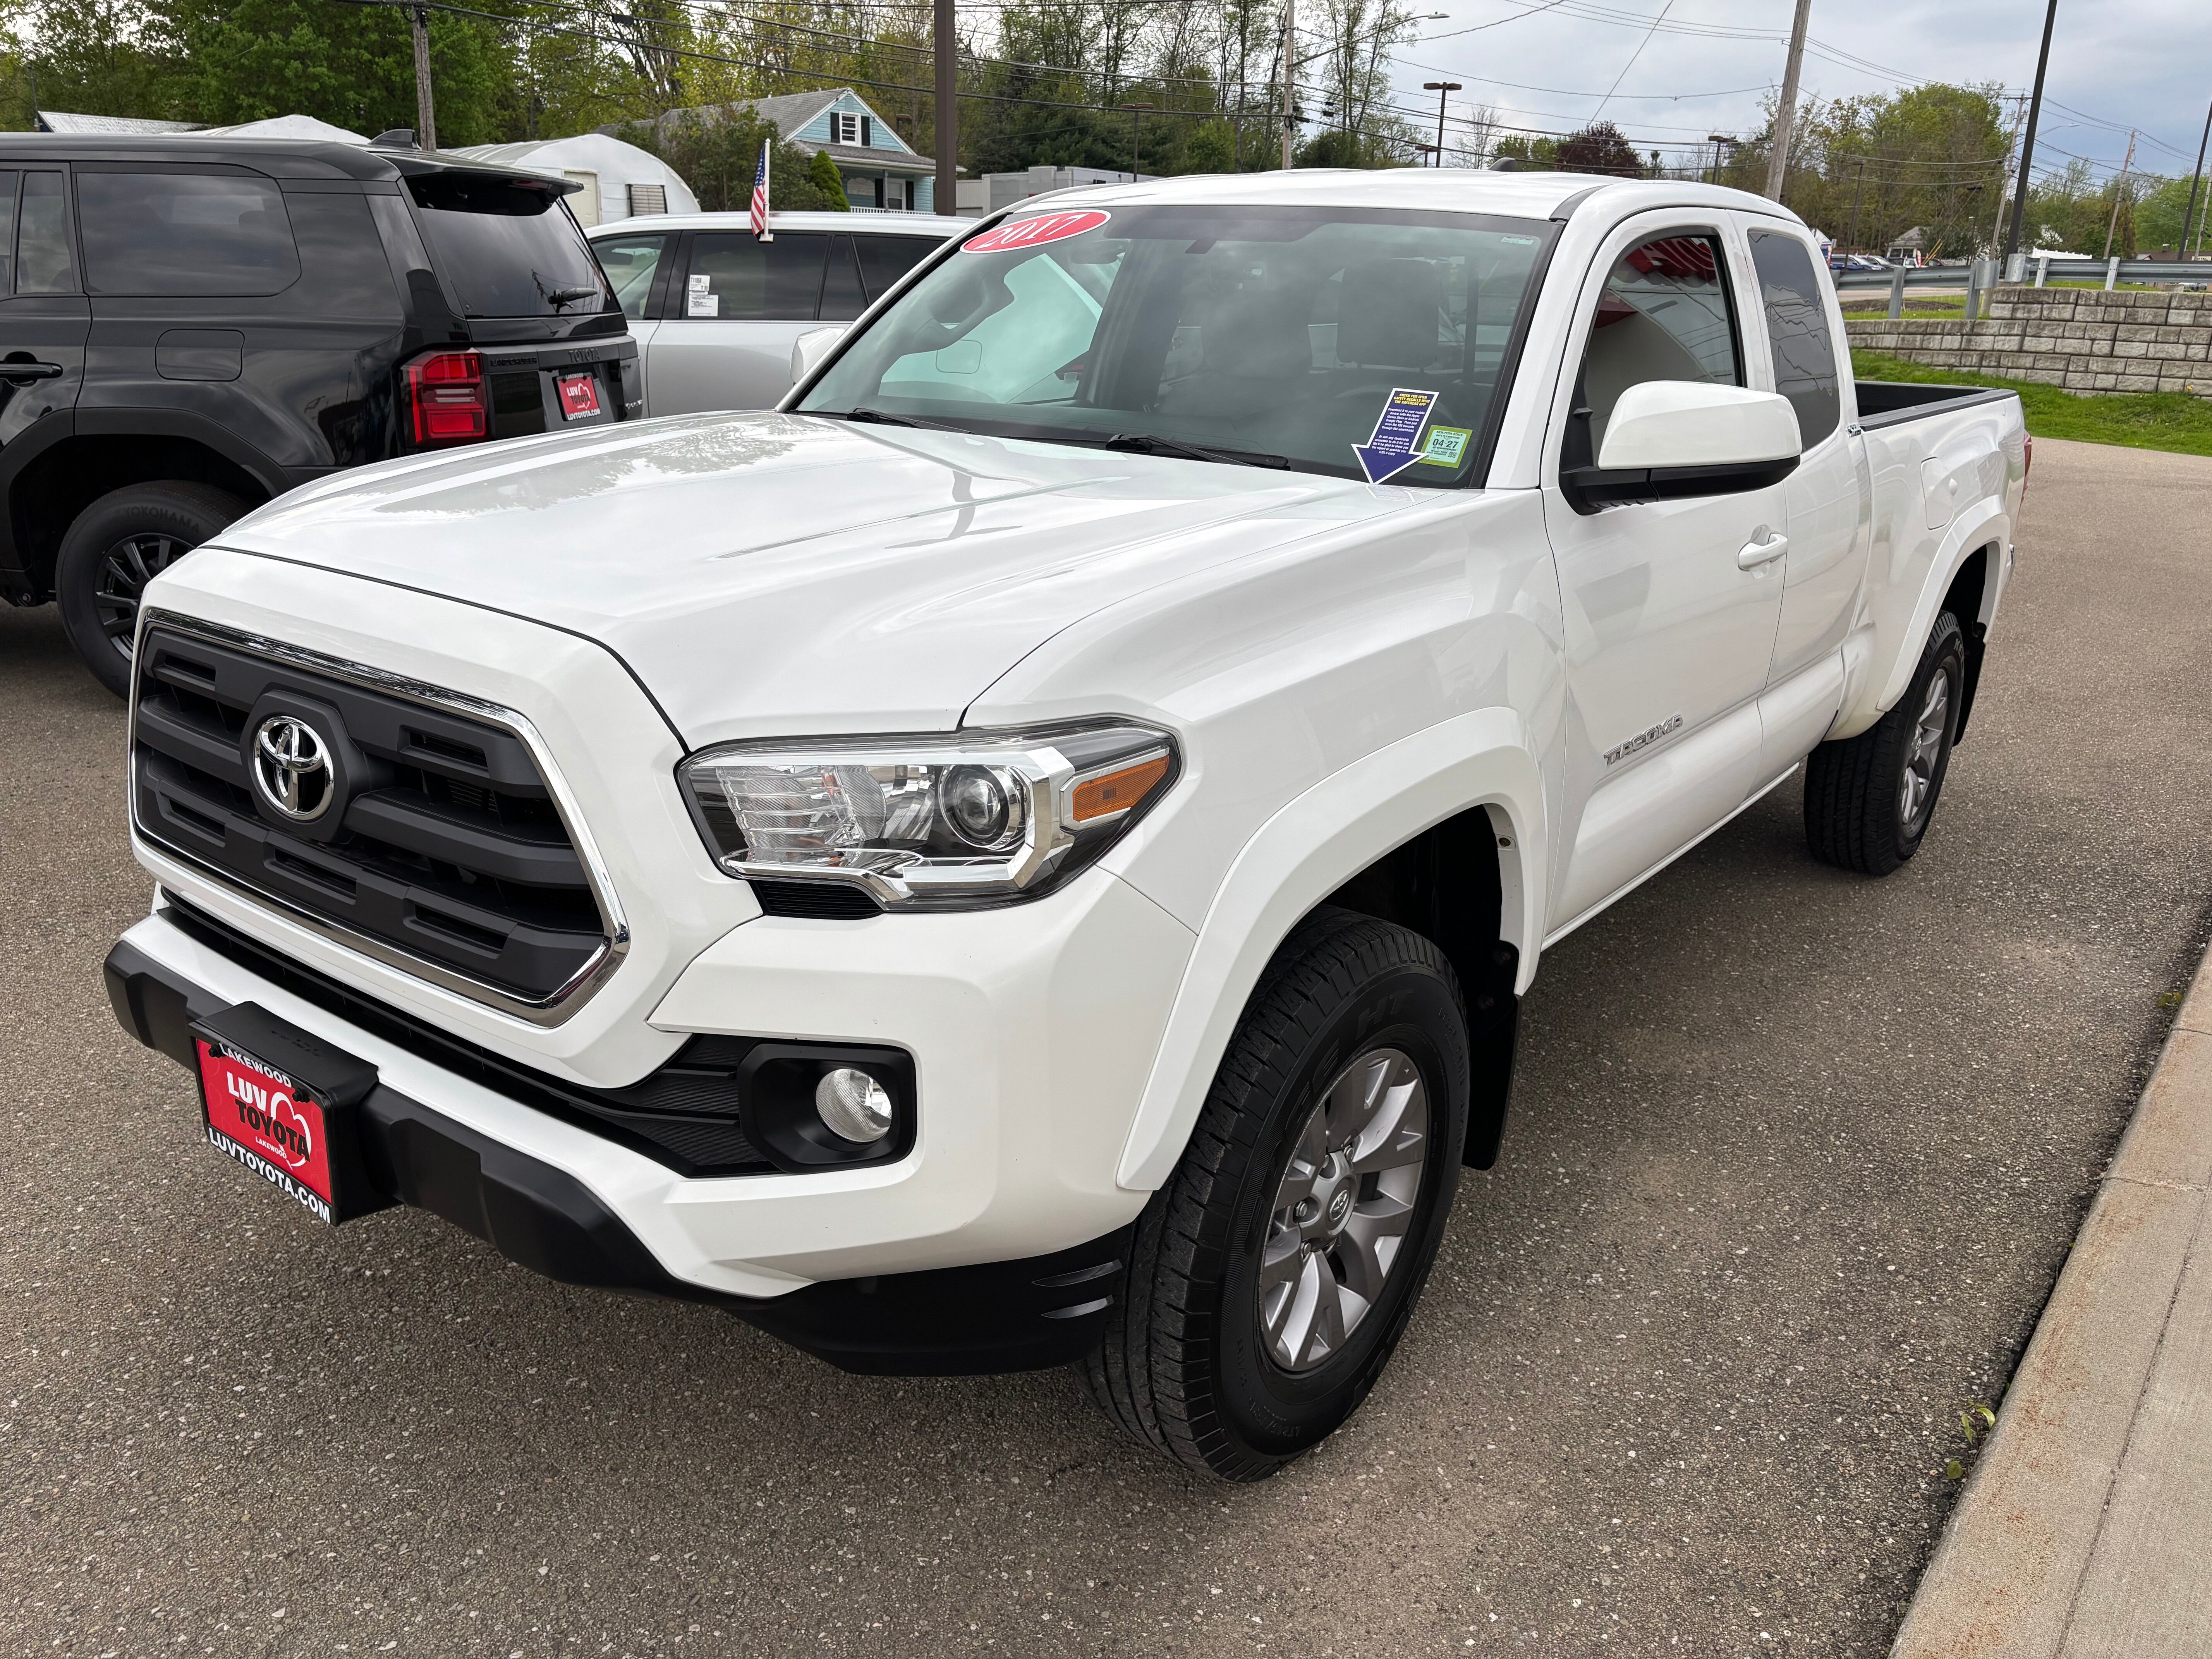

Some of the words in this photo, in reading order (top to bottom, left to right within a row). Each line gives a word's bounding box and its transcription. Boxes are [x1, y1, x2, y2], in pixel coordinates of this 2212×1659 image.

[973, 213, 1090, 250] 2017
[568, 349, 600, 362] TOYOTA
[567, 386, 578, 397] LUV
[570, 394, 590, 404] TOYOTA
[567, 408, 601, 421] LUVTOYOTA.COM
[124, 506, 199, 534] YOKOHAMA
[1604, 713, 1683, 765] TACOMA
[219, 1043, 292, 1088] LAKEWOOD
[227, 1071, 267, 1112] LUV
[235, 1098, 310, 1162] TOYOTA
[256, 1136, 287, 1159] LAKEWOOD
[209, 1128, 331, 1224] LUVTOYOTA.COM
